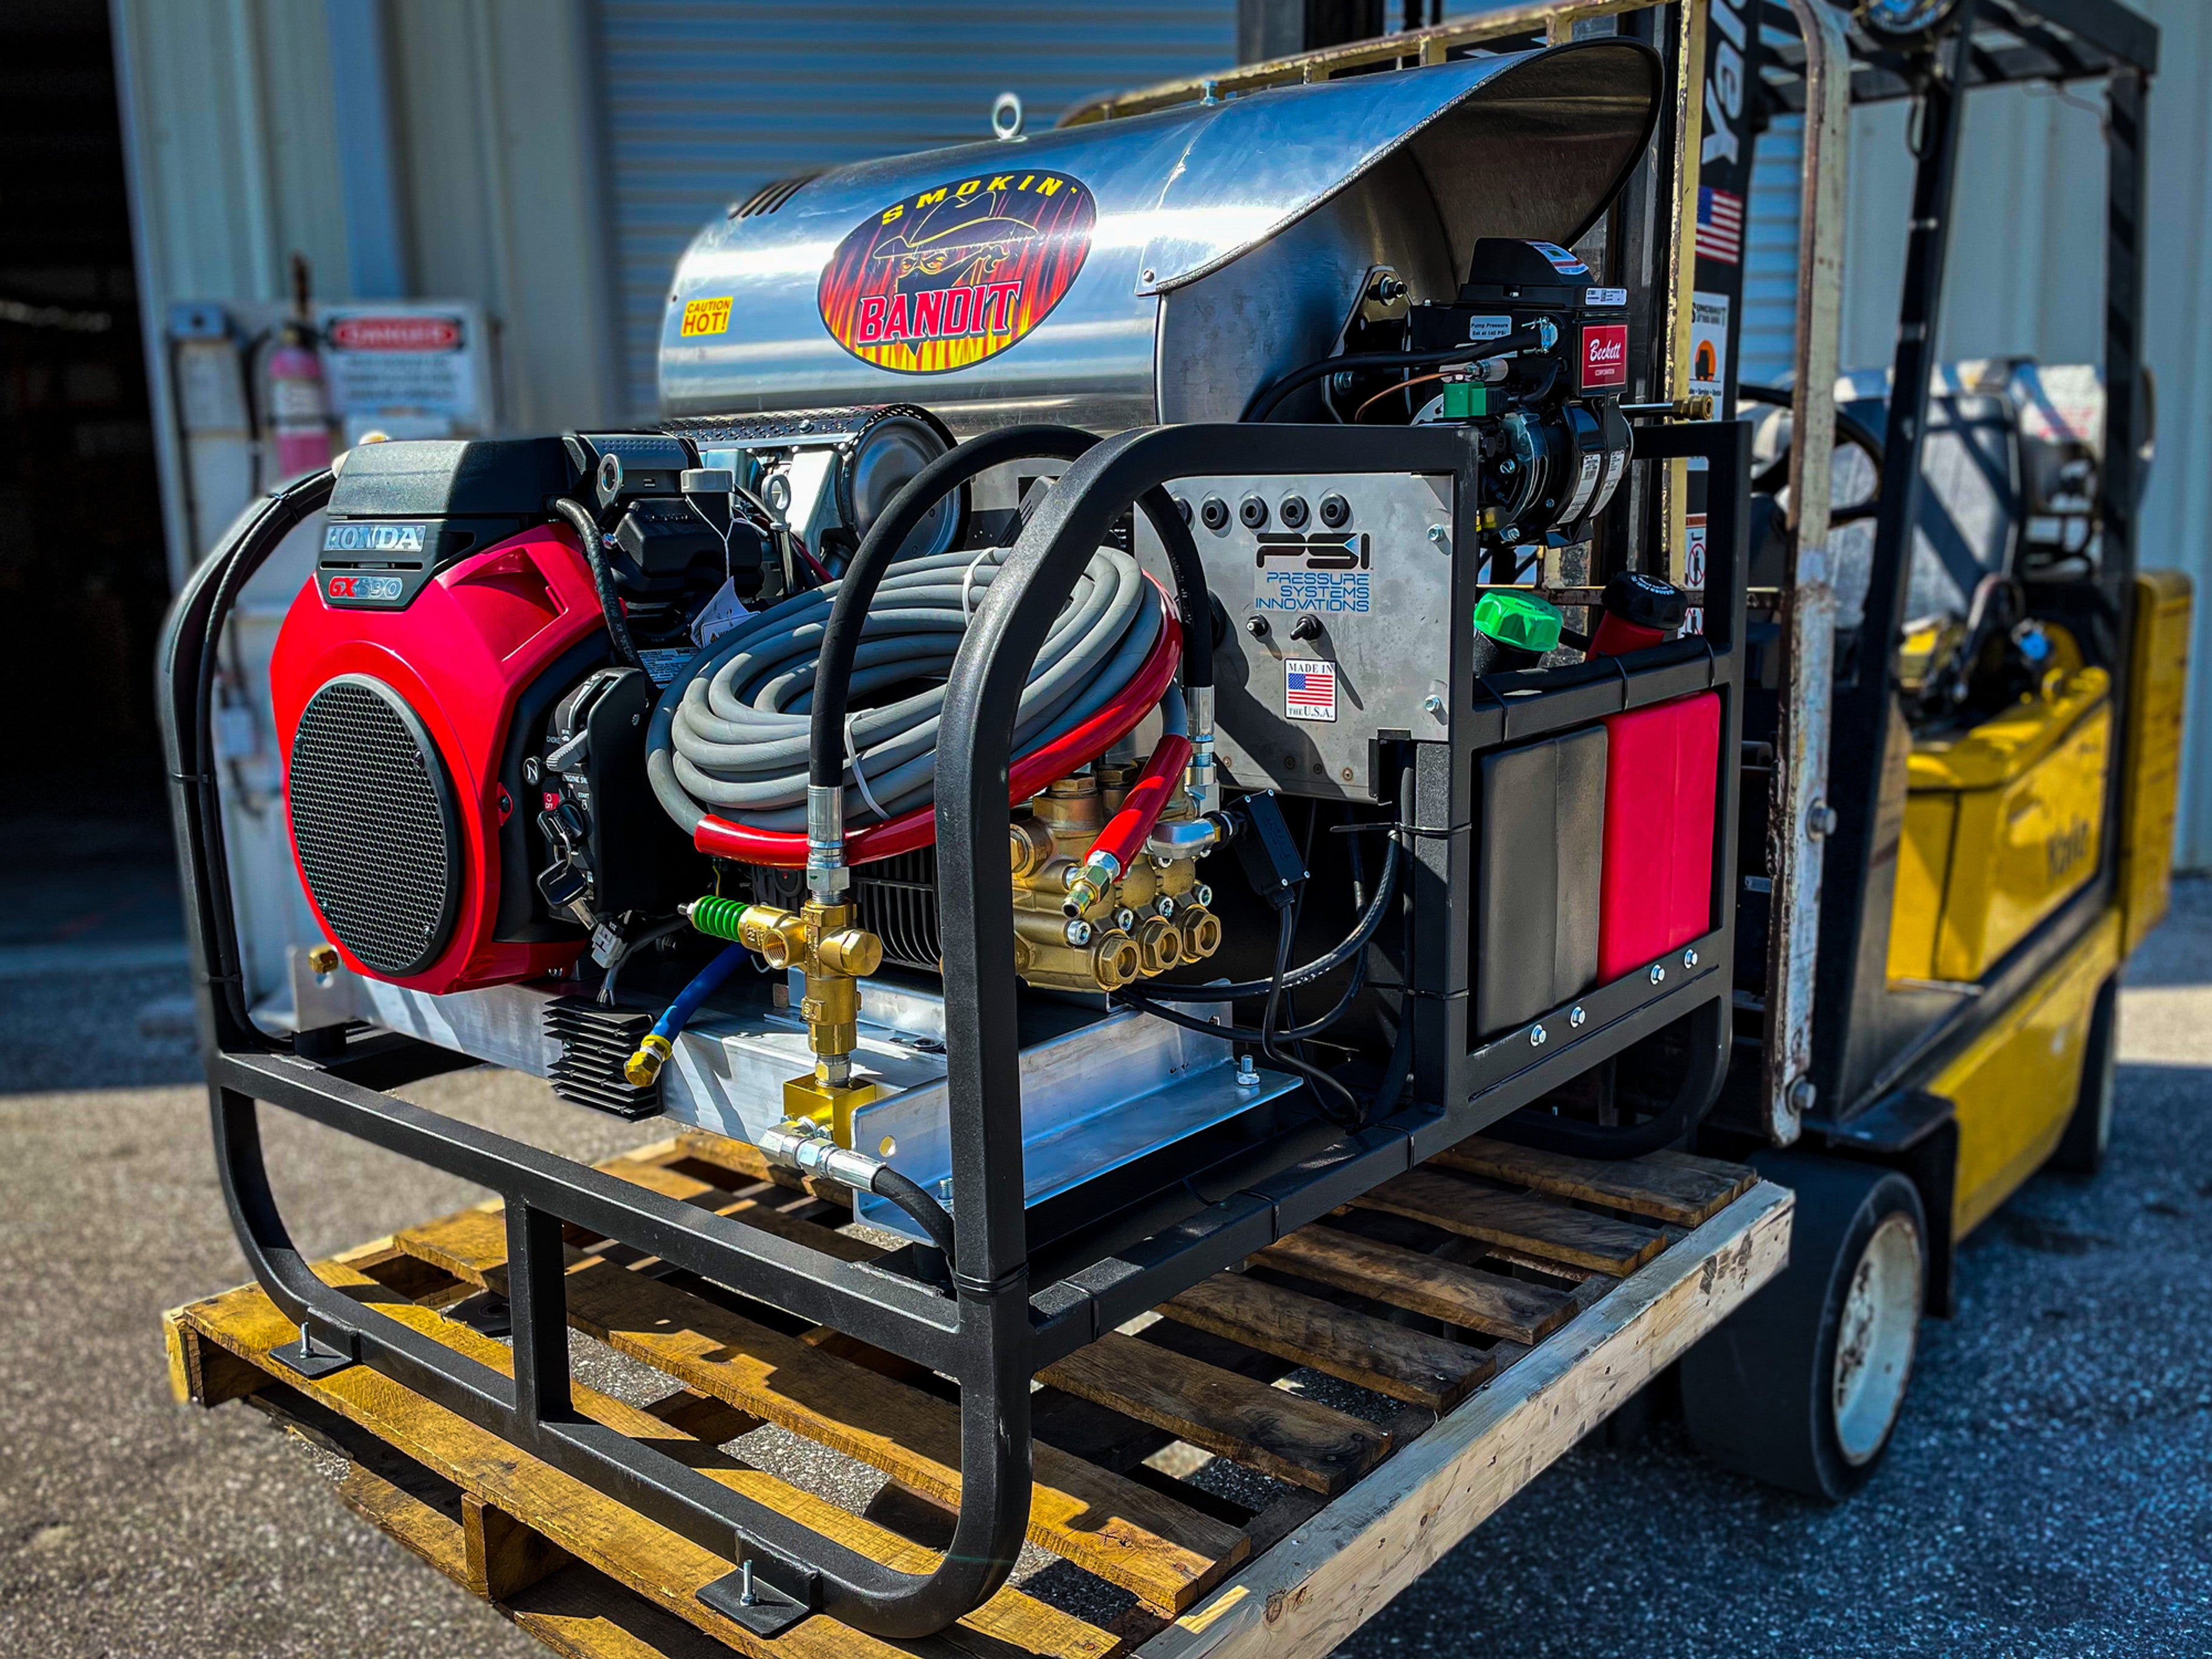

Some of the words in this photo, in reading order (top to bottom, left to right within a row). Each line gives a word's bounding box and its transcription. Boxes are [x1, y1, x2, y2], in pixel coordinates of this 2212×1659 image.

[1702, 0, 1746, 165] Yal
[687, 300, 730, 313] CAUTION
[858, 281, 1022, 343] BANDIT
[683, 311, 727, 334] HOT!
[1590, 338, 1621, 361] Beckett
[324, 527, 421, 550] HONDA
[1267, 571, 1370, 585] PRESSURE
[1280, 585, 1370, 599] SYSTEMS
[1256, 597, 1370, 612] INNOVATIONS
[1289, 663, 1318, 672] MADE
[1322, 665, 1333, 673] IN
[1304, 706, 1333, 718] U.S.A.
